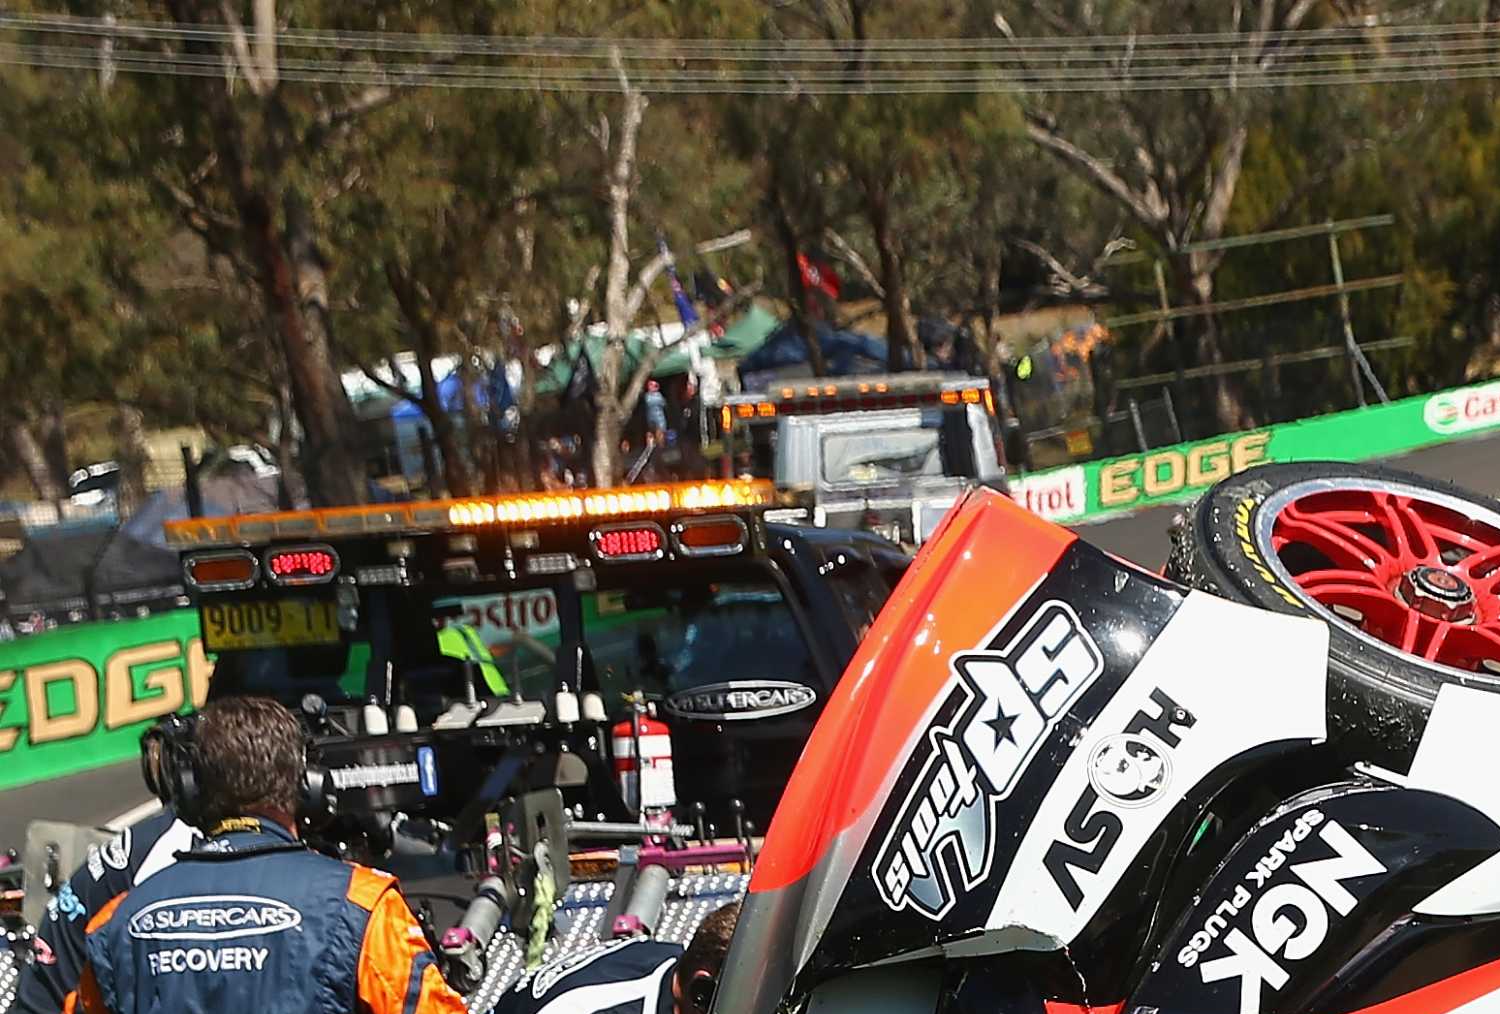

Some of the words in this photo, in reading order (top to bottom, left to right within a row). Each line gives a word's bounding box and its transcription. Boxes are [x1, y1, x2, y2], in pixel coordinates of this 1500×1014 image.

[1101, 431, 1275, 504] EDGE
[1243, 808, 1325, 884] SPARK
[148, 946, 269, 977] RECOVERY
[1176, 887, 1250, 969] PLUGS
